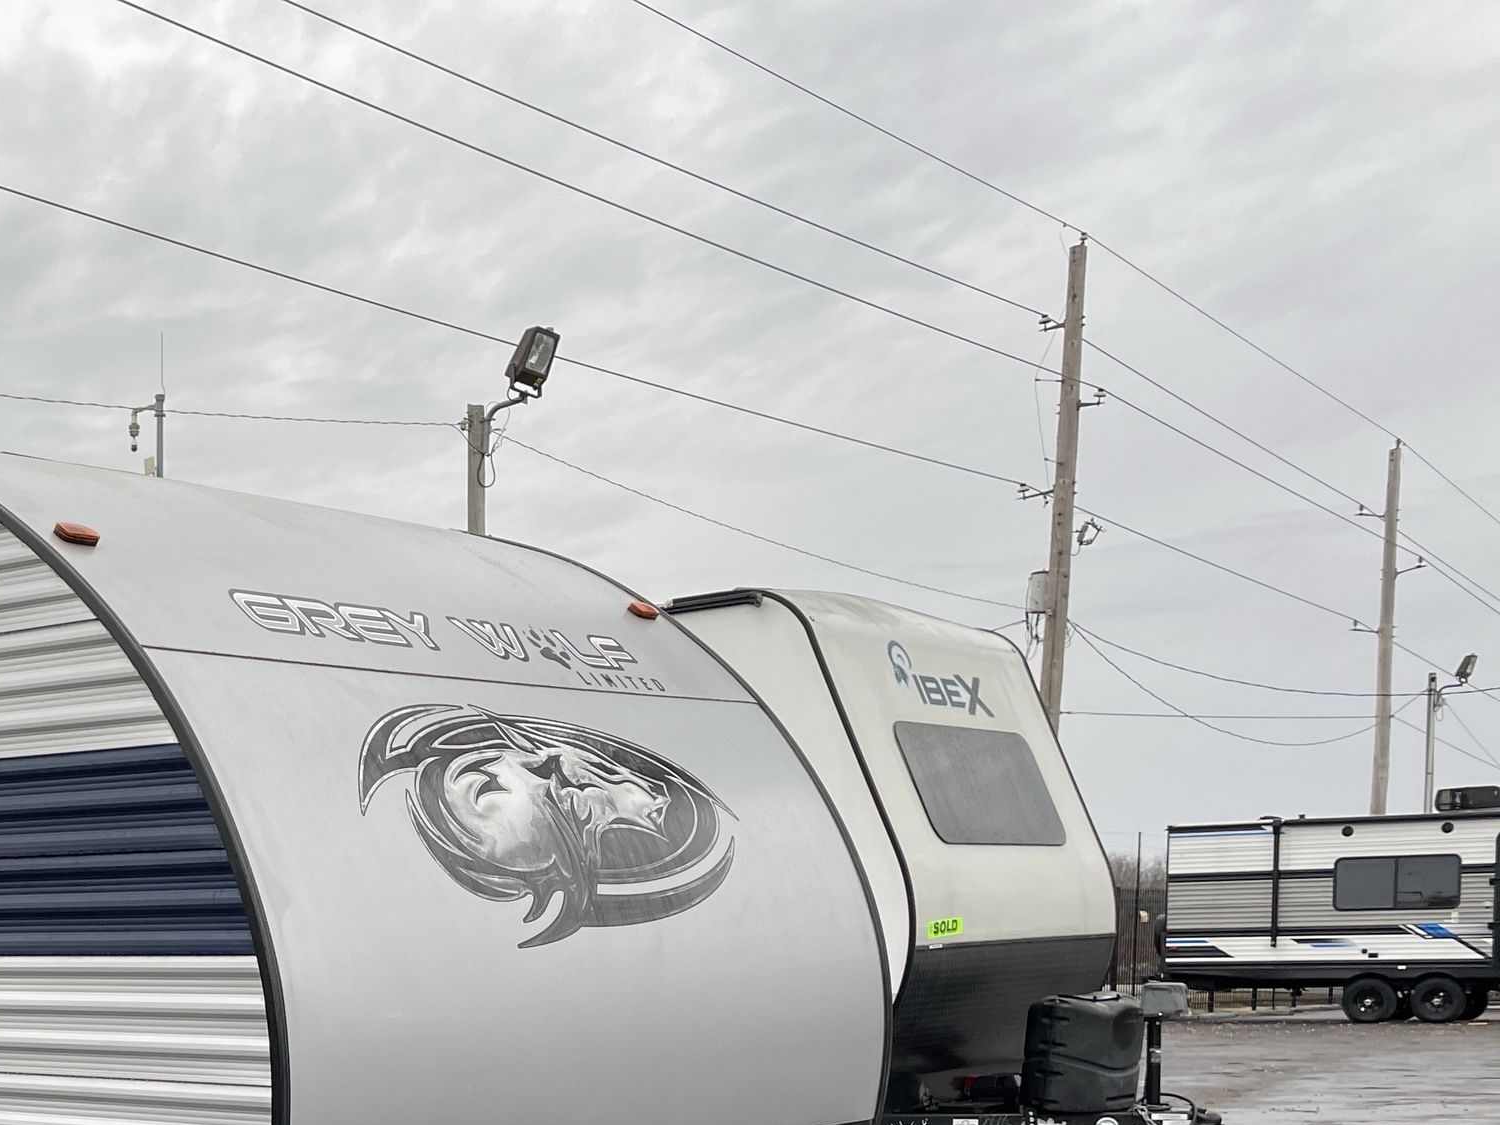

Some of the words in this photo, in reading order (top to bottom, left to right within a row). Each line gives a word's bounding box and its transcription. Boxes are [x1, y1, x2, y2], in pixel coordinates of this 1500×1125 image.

[228, 588, 440, 651] GREY
[576, 671, 666, 692] LIMITED
[912, 673, 995, 718] IBEX
[932, 919, 957, 935] SOLD
